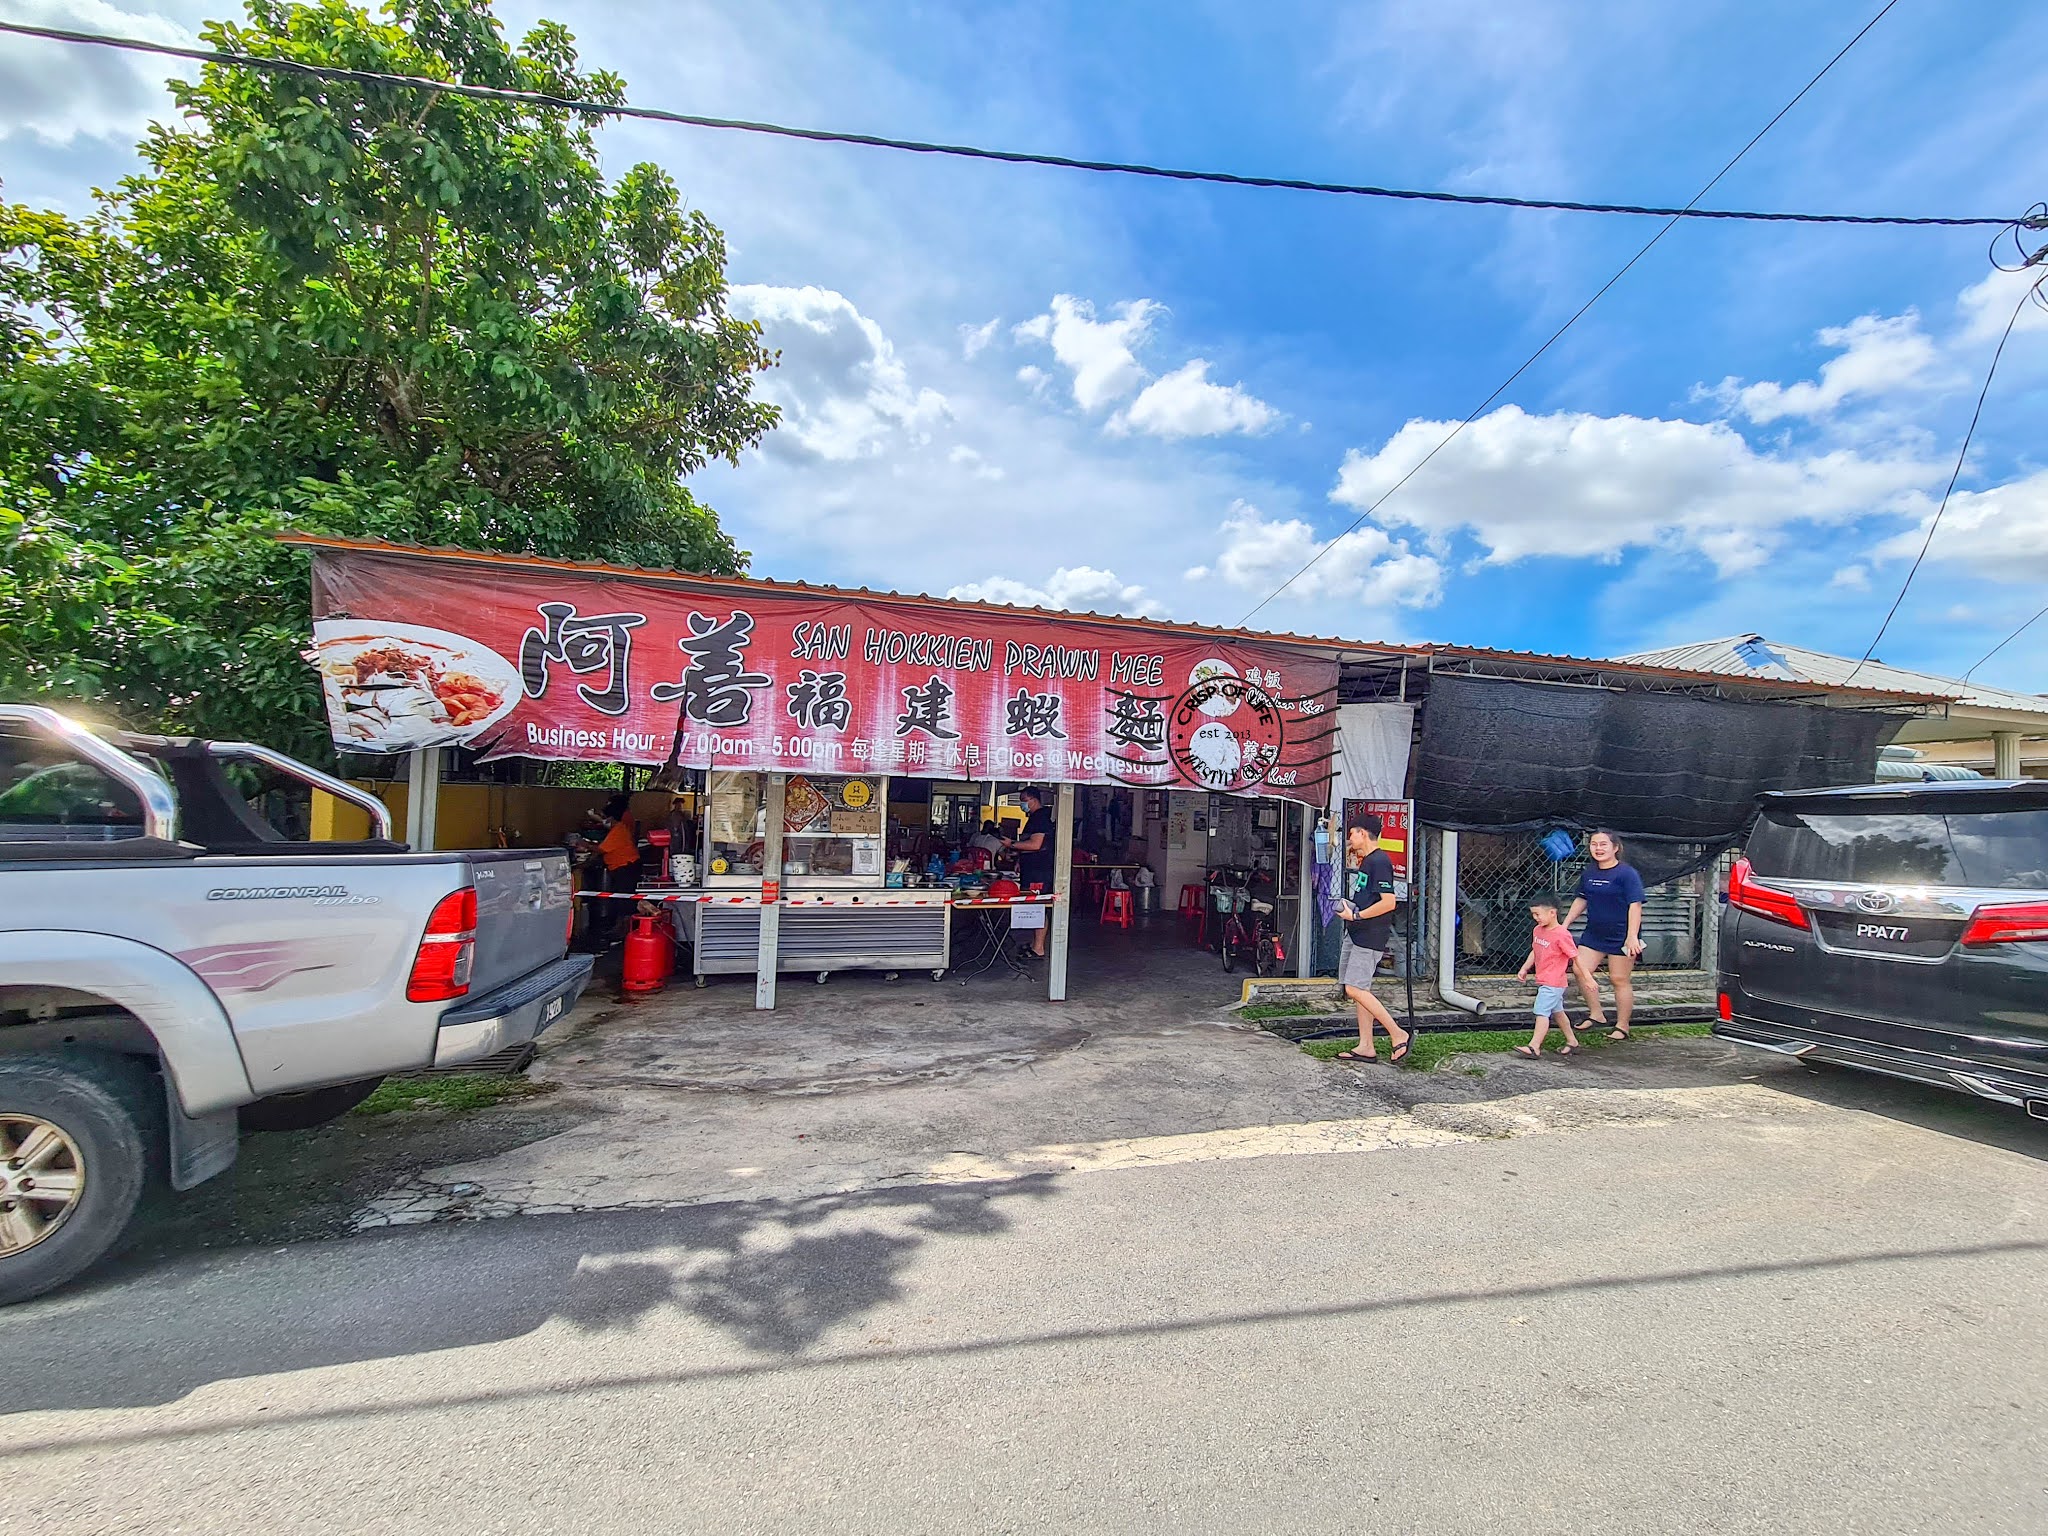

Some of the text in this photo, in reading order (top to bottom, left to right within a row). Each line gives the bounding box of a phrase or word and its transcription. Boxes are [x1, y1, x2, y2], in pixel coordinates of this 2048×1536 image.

[791, 620, 1163, 686] SAN HOKKIEN PRAWN MEE
[526, 722, 605, 748] Business
[612, 728, 655, 750] Hour
[769, 736, 842, 762] 5.00pm
[995, 747, 1043, 768] Close
[1067, 750, 1163, 778] Wednesday
[206, 885, 349, 901] COMMONRAIL
[313, 895, 381, 906] turbo
[1856, 923, 1909, 941] PPA77
[1742, 940, 1795, 953] ALPHARD
